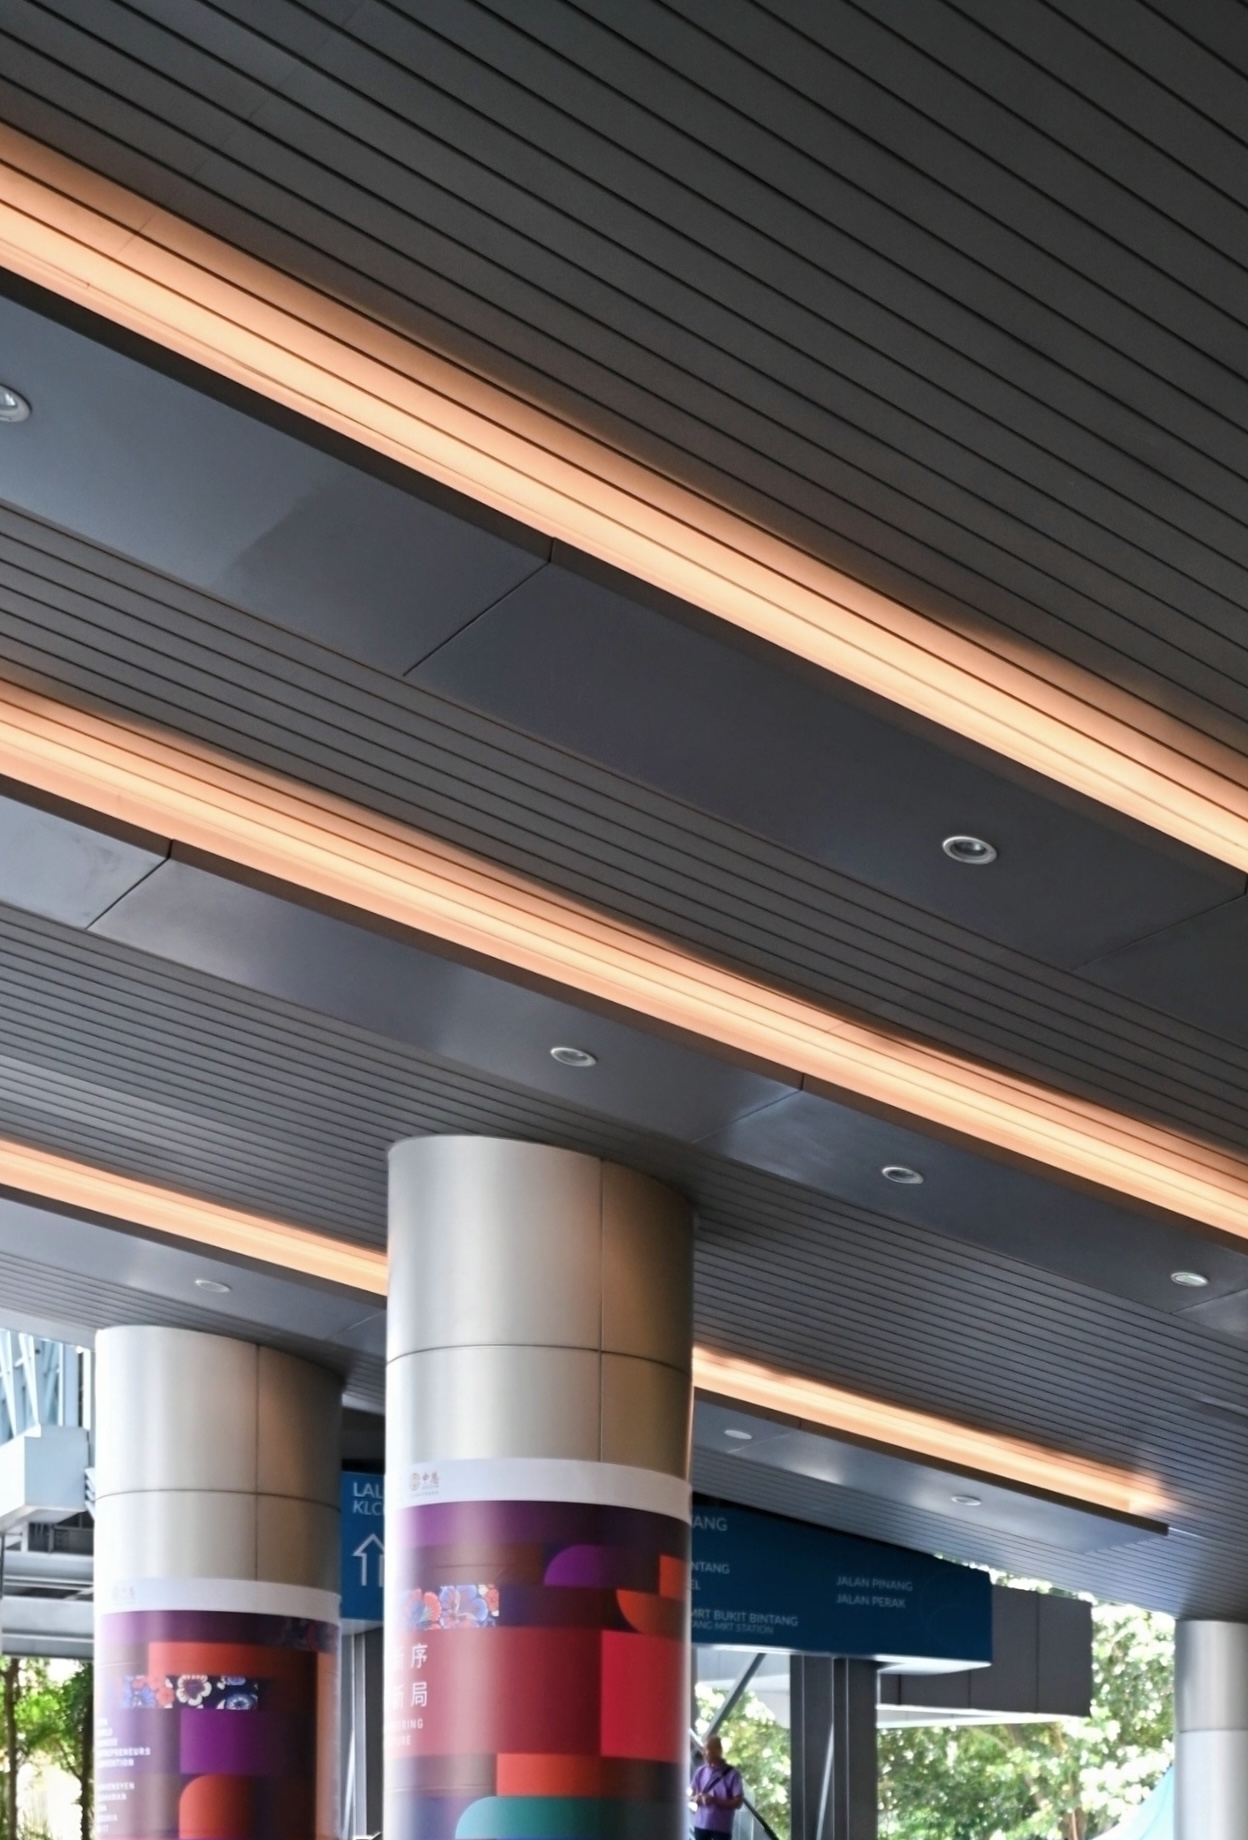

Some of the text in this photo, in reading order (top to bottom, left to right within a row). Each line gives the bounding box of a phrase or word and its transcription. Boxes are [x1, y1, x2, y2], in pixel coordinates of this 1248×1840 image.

[353, 1482, 384, 1499] LAL
[353, 1500, 384, 1516] KLC
[692, 1515, 728, 1531] ANG
[692, 1561, 730, 1575] NTANG
[836, 1575, 913, 1592] JALAN PINANG
[836, 1593, 906, 1609] JALAN PERAK
[713, 1609, 747, 1623] BUKIT
[749, 1612, 798, 1627] BINTANG
